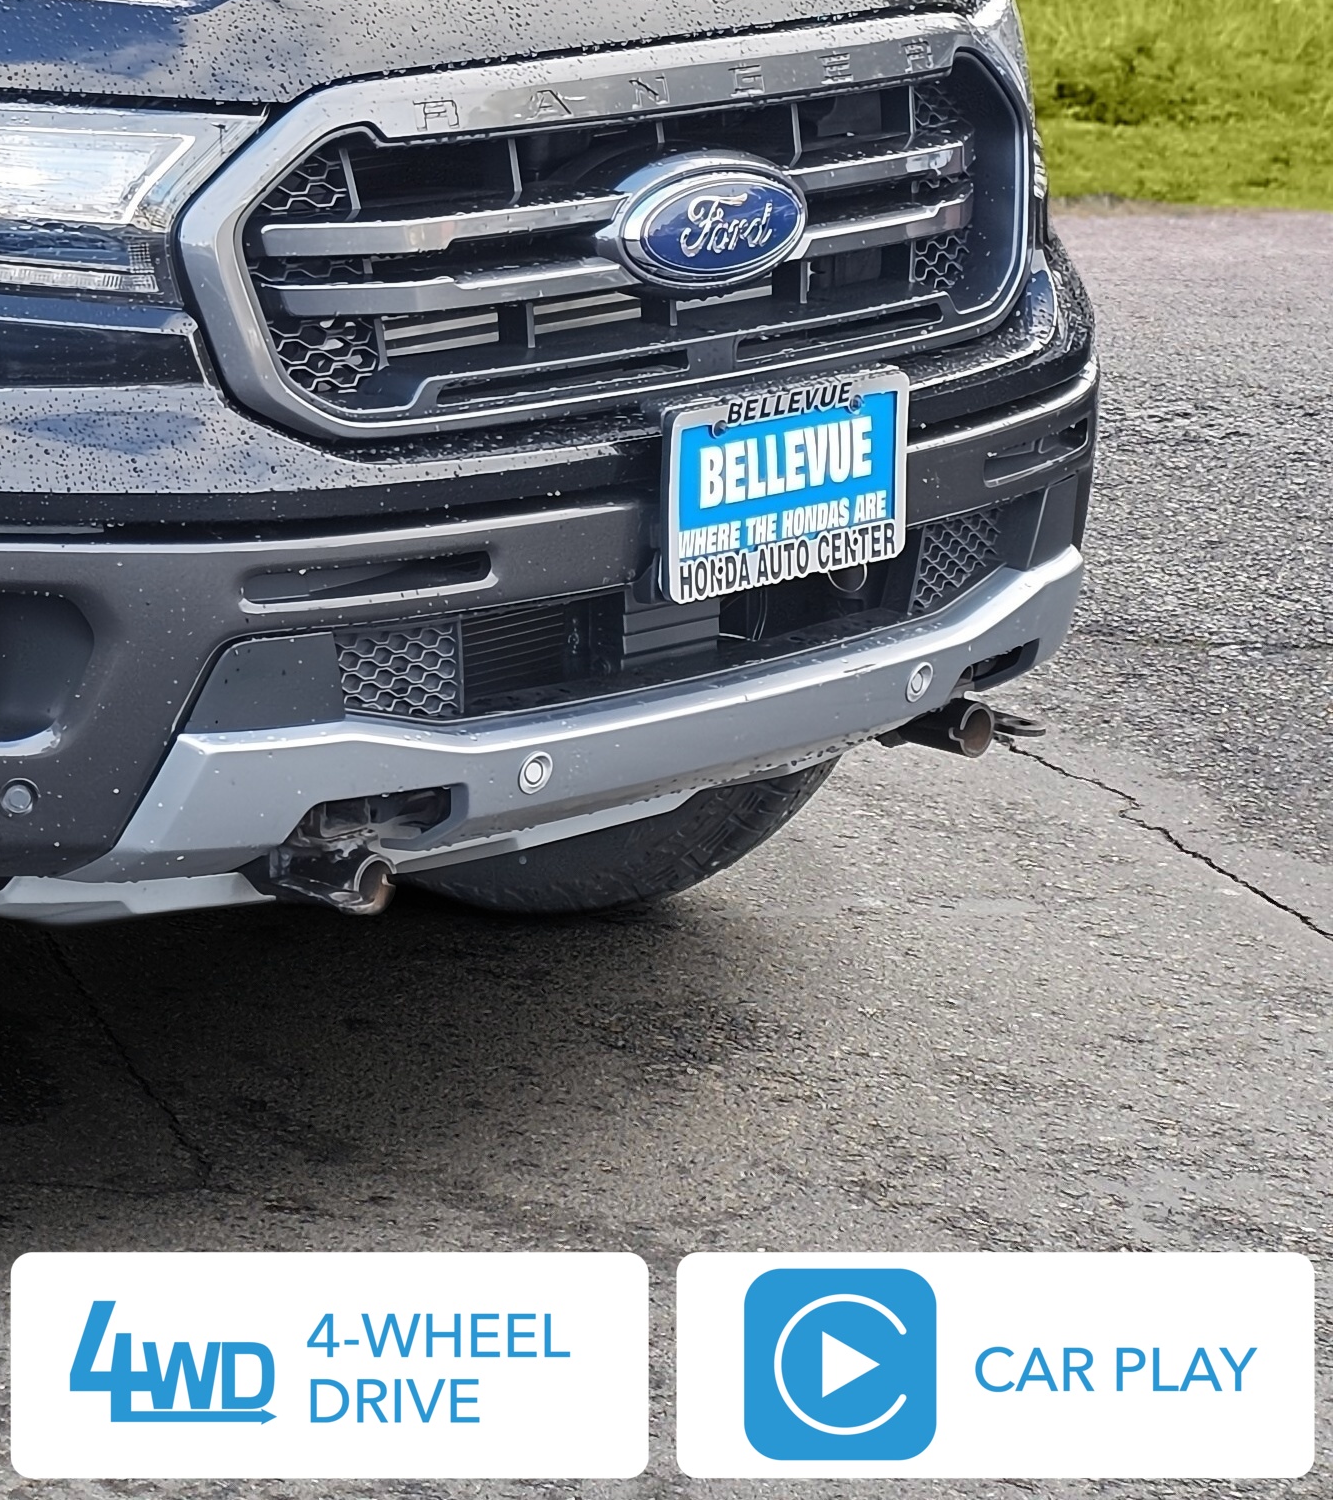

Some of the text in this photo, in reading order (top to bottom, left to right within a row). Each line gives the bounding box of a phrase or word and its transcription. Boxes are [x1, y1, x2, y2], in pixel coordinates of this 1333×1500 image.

[413, 39, 935, 132] RANGER
[680, 192, 773, 258] Ford
[727, 381, 853, 424] BELLEVUE
[699, 415, 873, 510] BELLEVUE
[678, 489, 887, 558] WHERE THE HONDAS ARE
[679, 522, 896, 601] HONDA AUTO CENTER
